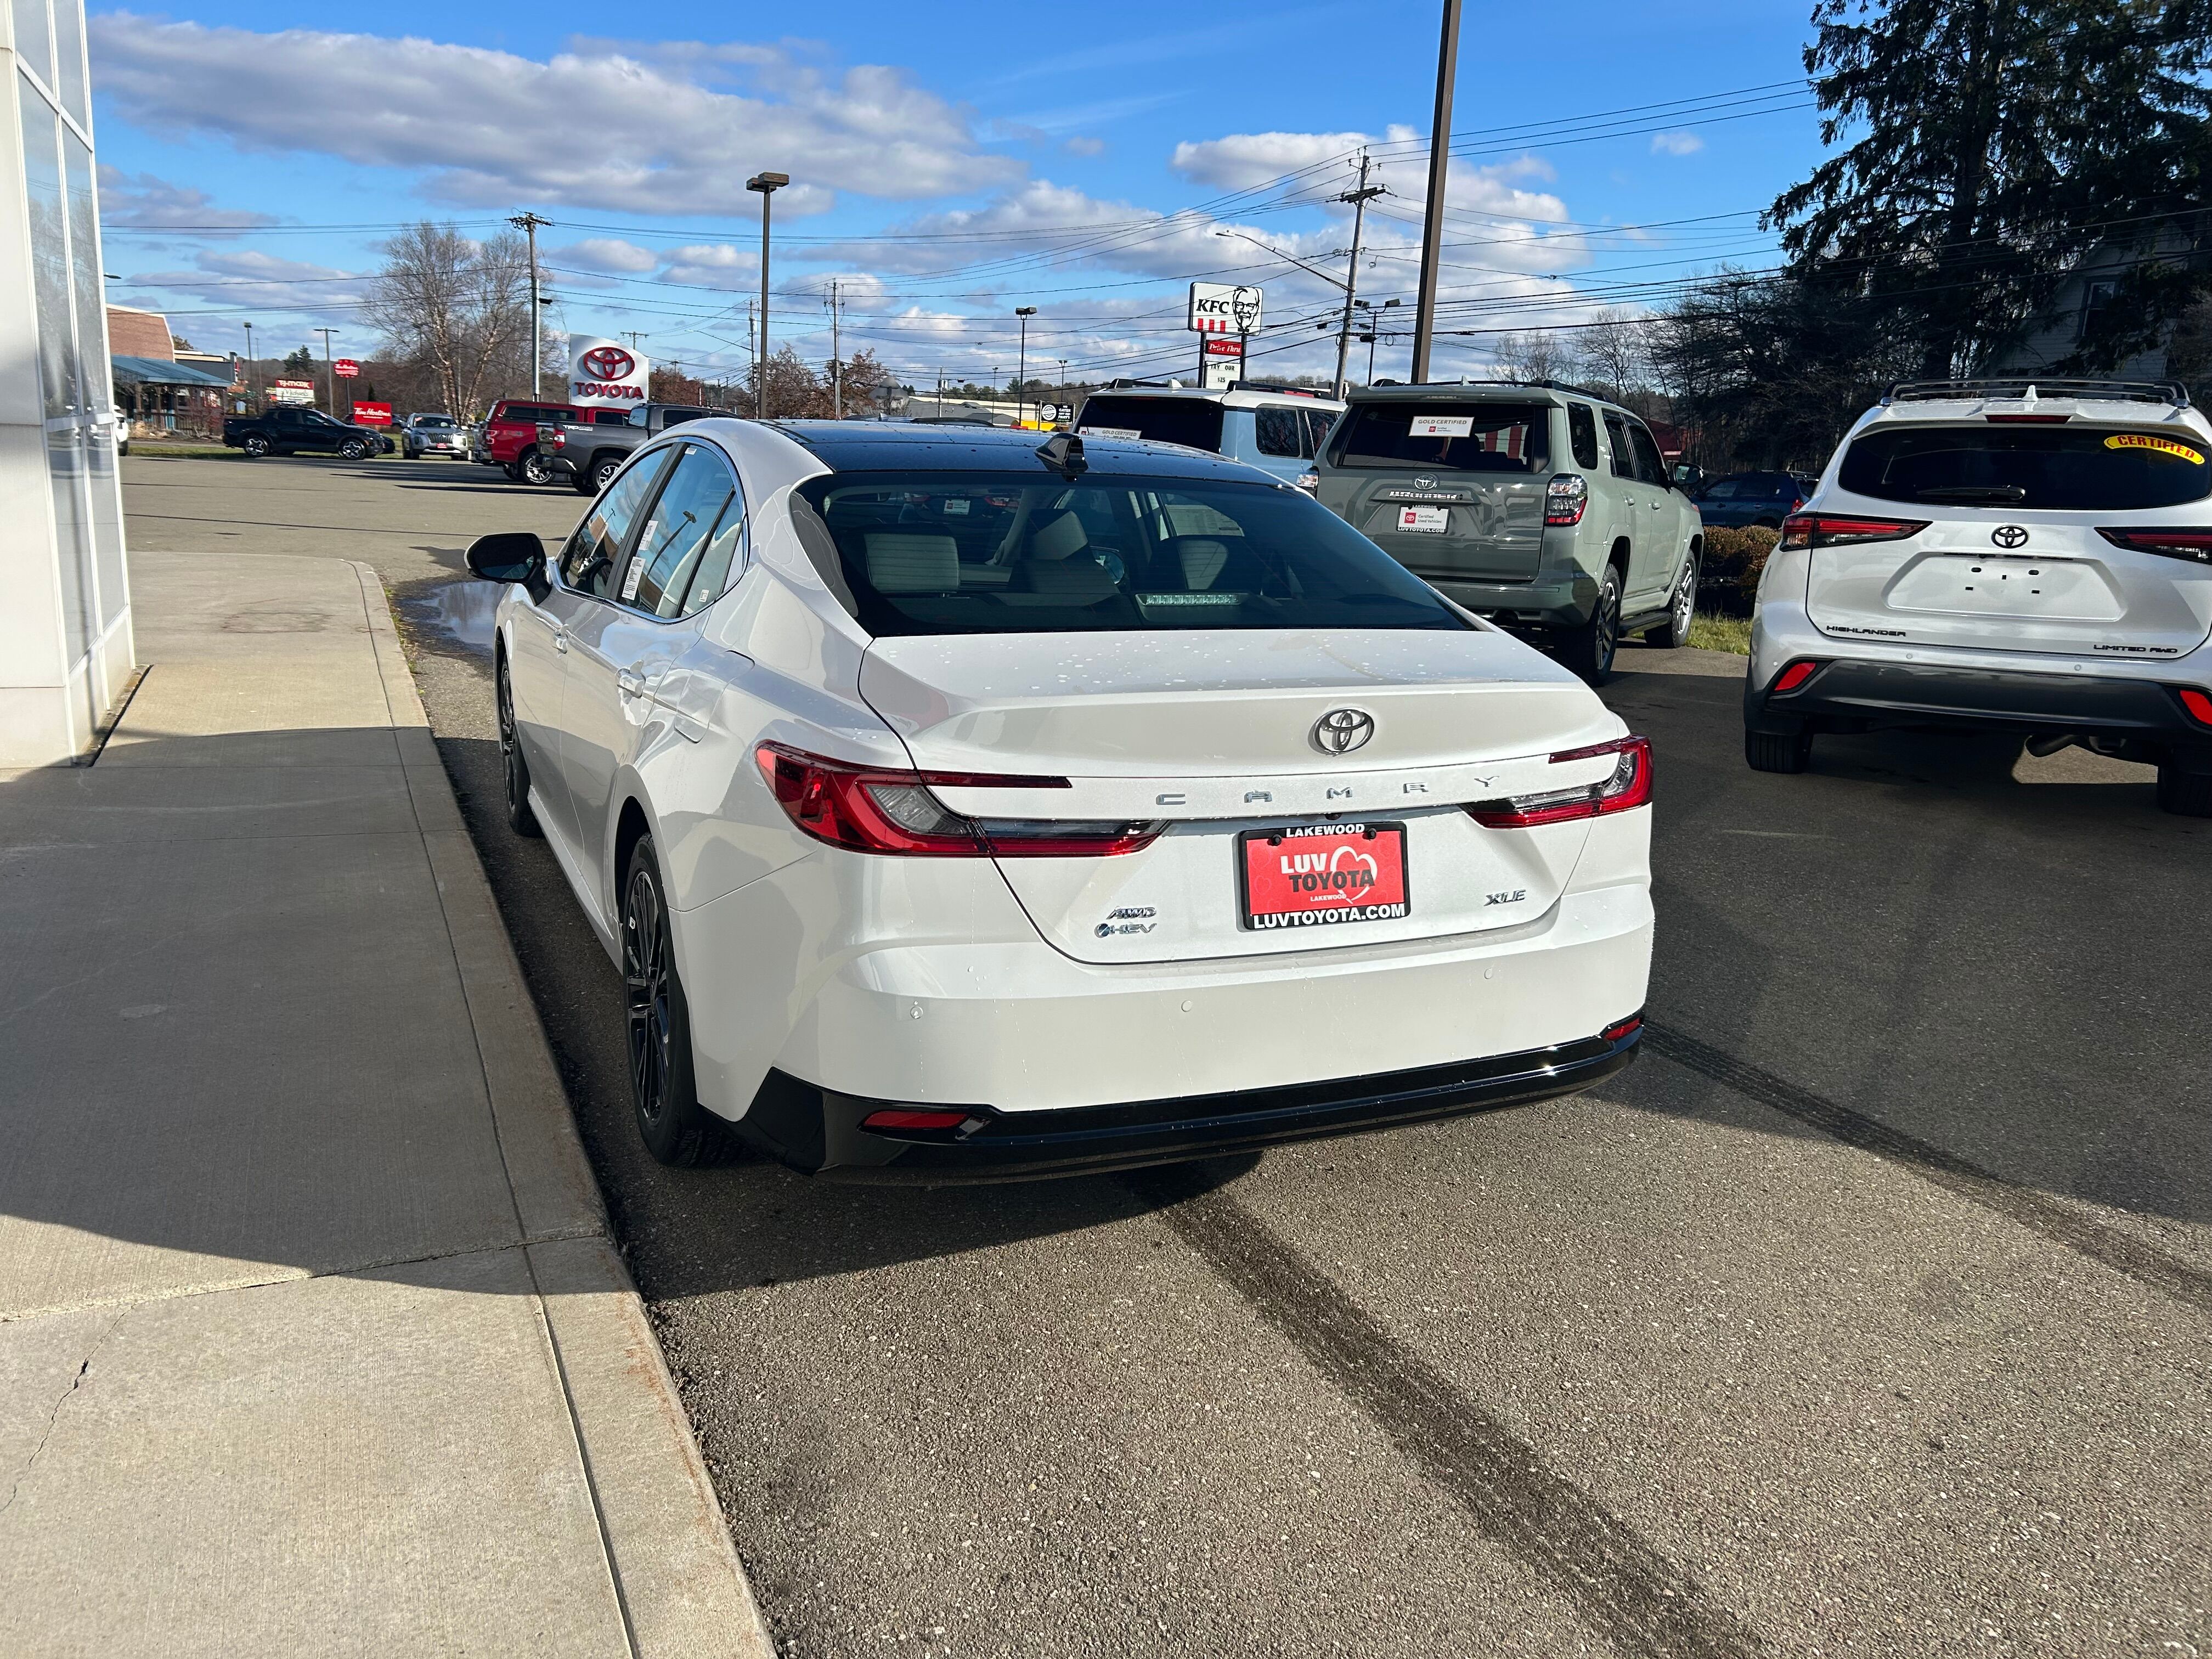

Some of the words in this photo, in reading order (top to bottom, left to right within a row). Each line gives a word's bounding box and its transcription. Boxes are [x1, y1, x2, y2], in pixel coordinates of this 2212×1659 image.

[1196, 299, 1229, 314] KFC
[573, 381, 645, 399] TOYOTA
[2117, 436, 2195, 459] CERTIFIED
[1826, 625, 1906, 637] HIGHLANDER
[2093, 644, 2147, 652] LIMITED
[1155, 775, 1500, 806] CAMRY
[1286, 823, 1365, 838] LAKEWOOD
[1280, 853, 1328, 874] LUV
[1289, 869, 1376, 893] TOYOTA
[1310, 892, 1347, 902] LAKEWOOD
[1483, 889, 1526, 906] XLE
[1105, 906, 1157, 919] AWD
[1253, 903, 1406, 929] LUVTOYOTA.COM
